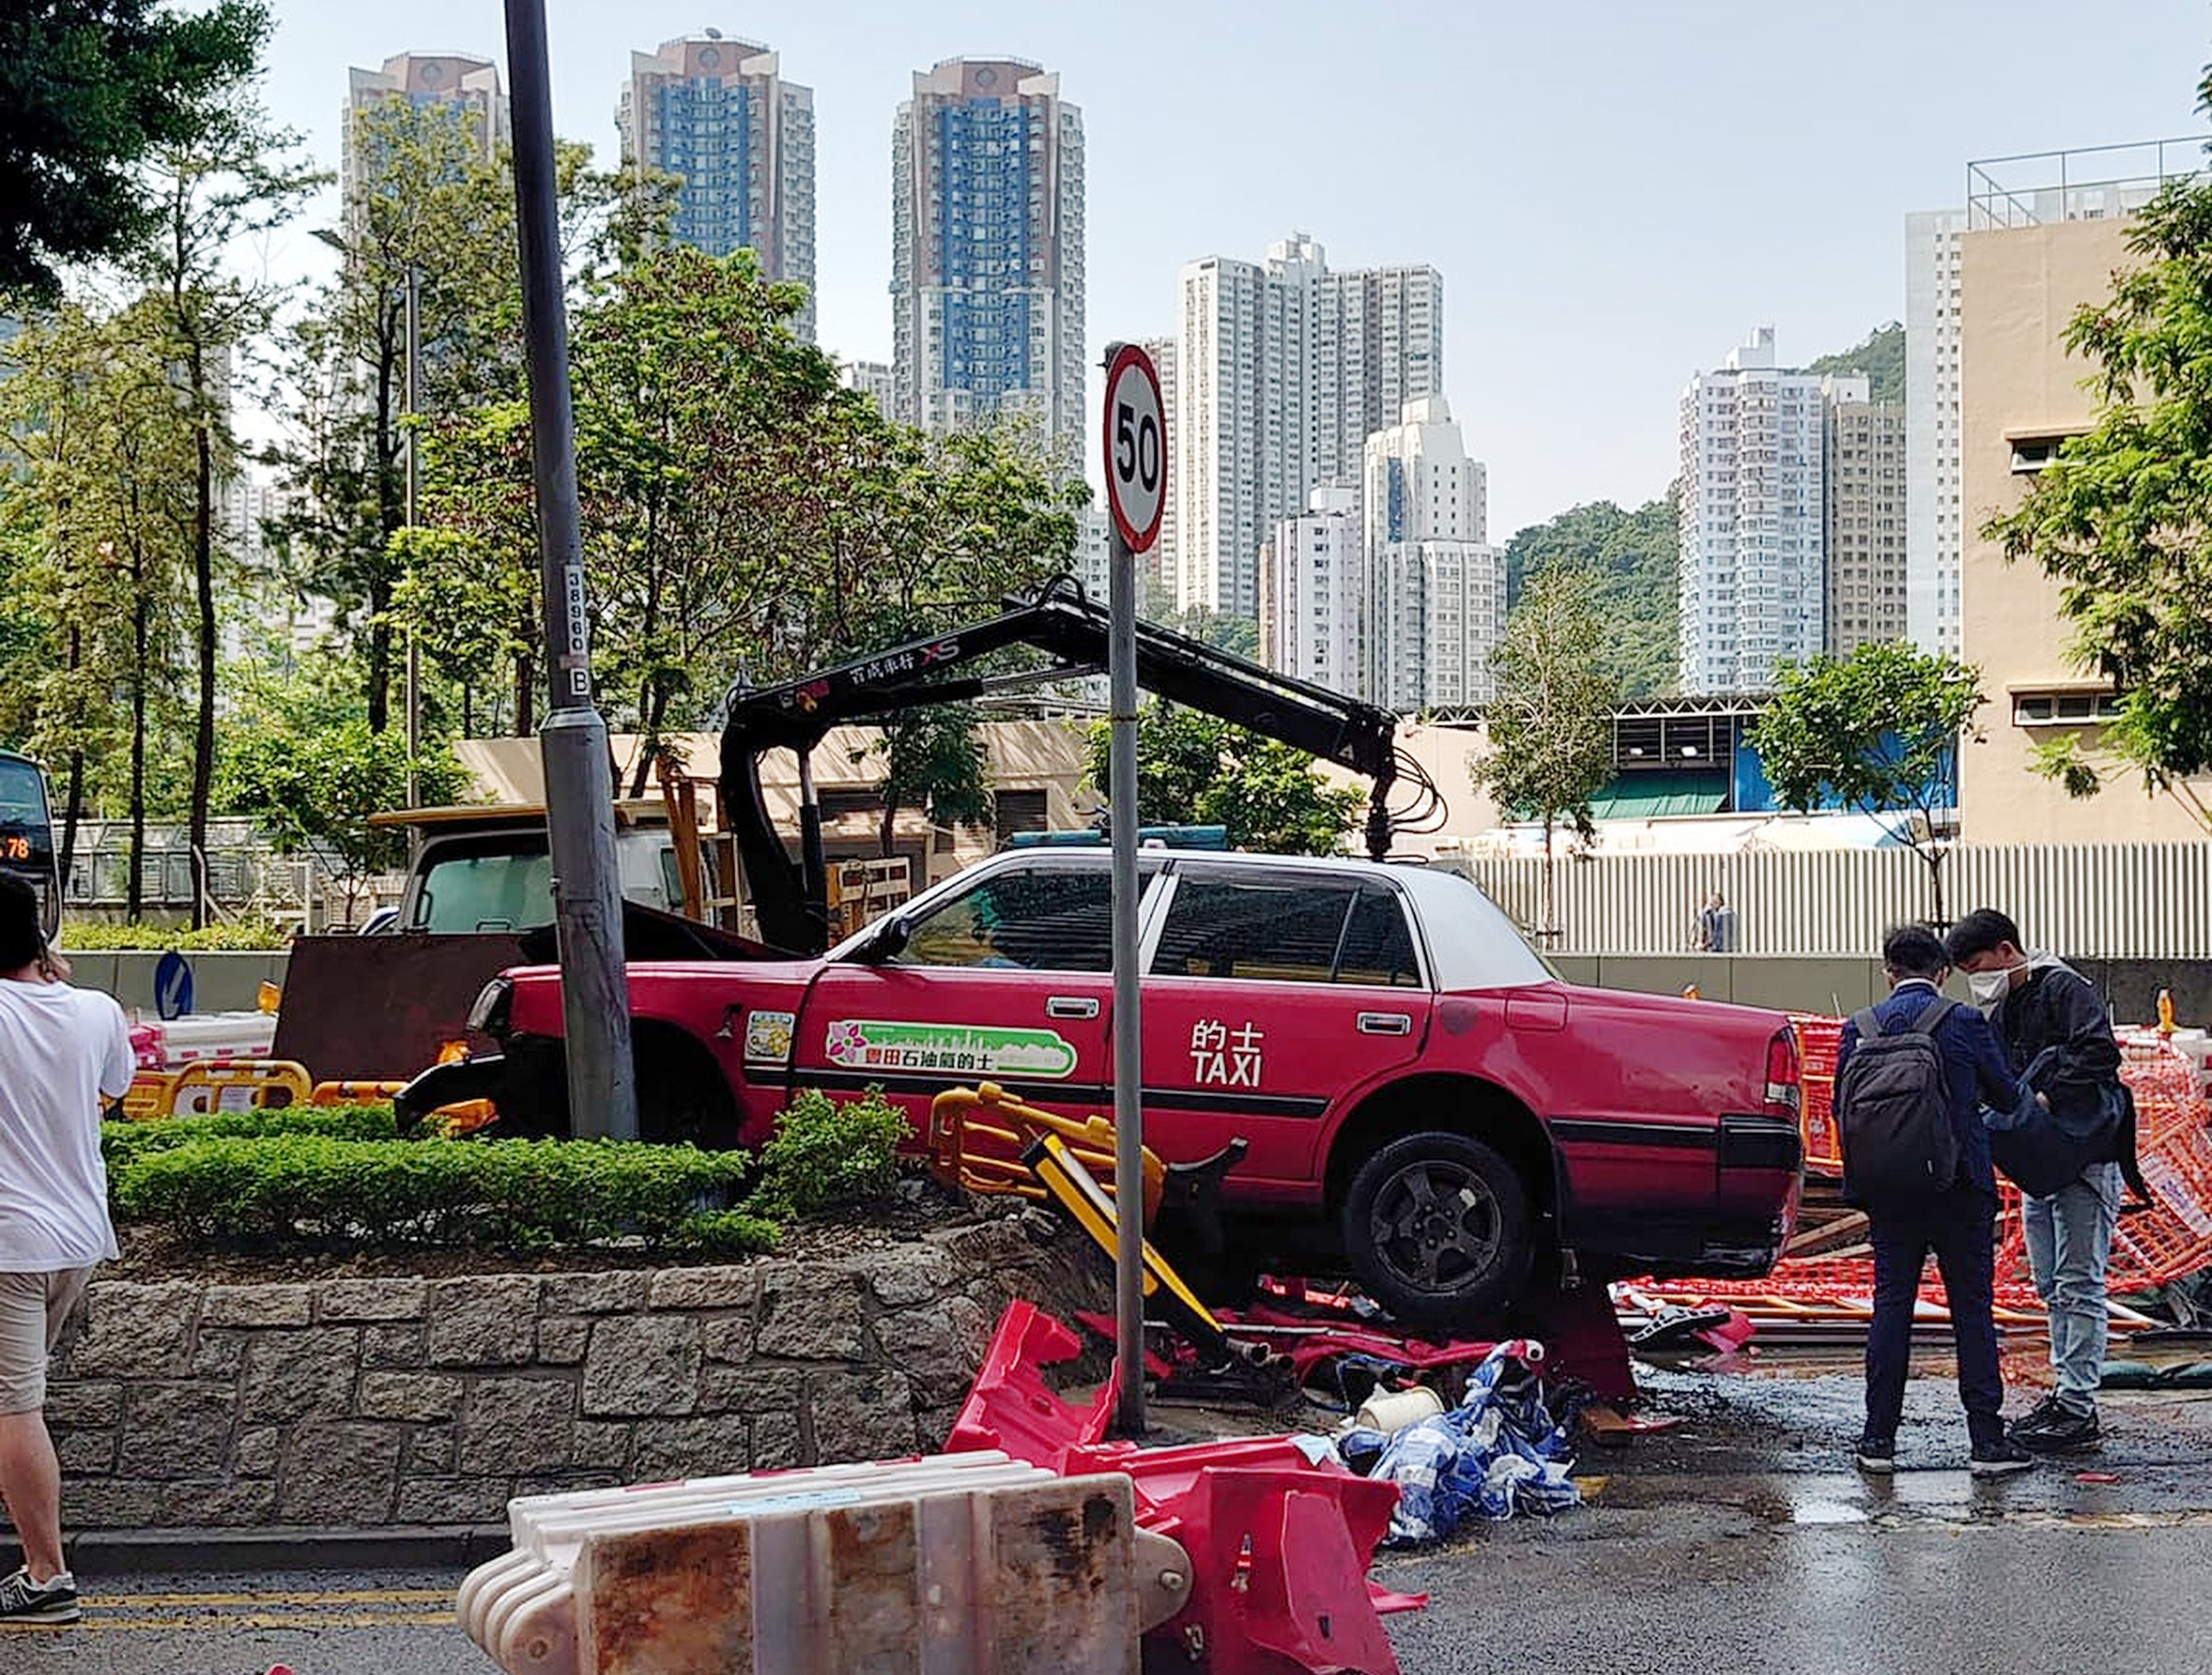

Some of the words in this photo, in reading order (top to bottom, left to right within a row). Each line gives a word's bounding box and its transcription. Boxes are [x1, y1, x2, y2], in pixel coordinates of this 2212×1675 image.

[1117, 401, 1158, 492] 50
[574, 671, 587, 692] B
[8, 838, 30, 859] 78
[1191, 1019, 1264, 1053] 的士
[1190, 1051, 1261, 1087] TAXI
